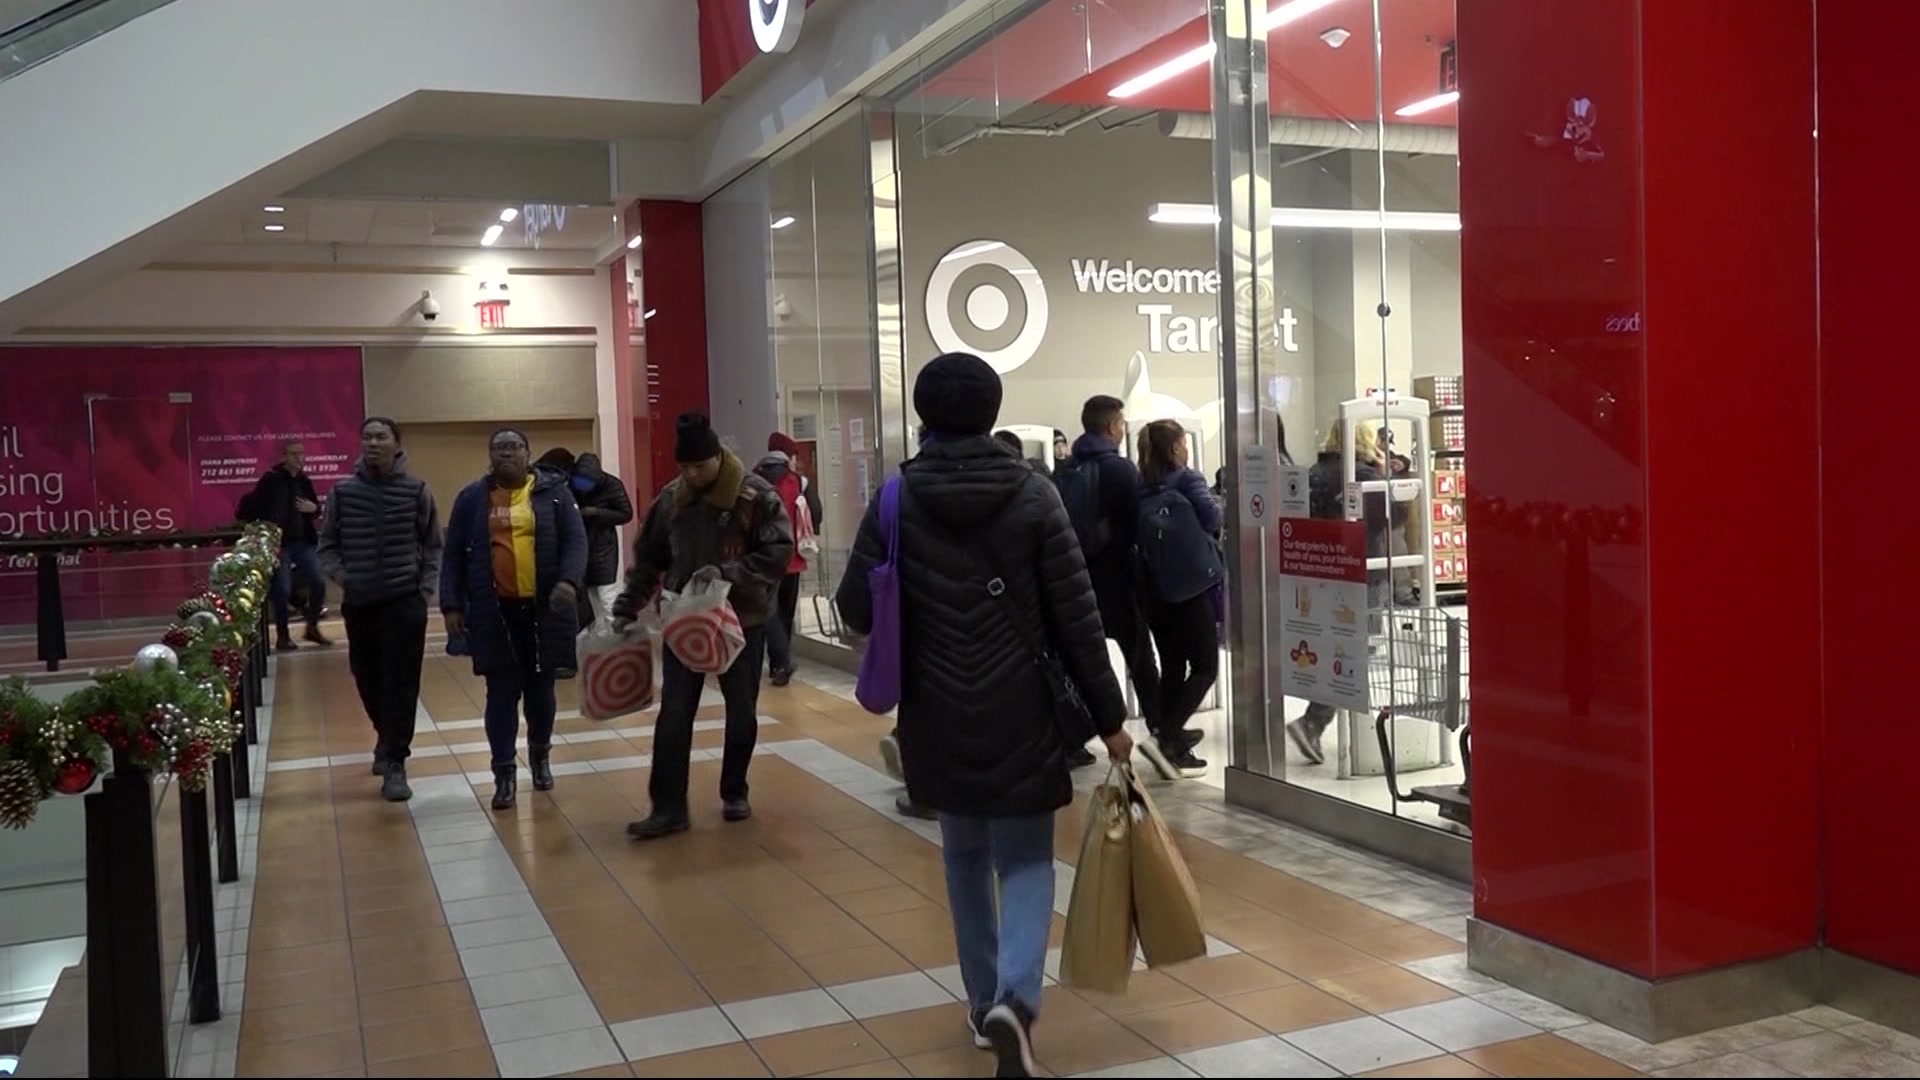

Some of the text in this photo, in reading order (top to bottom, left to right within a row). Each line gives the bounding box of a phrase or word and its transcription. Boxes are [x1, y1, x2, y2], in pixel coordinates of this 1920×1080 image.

[1071, 258, 1221, 294] Welcome
[480, 303, 506, 327] EXIT
[1138, 304, 1299, 353] Tart
[278, 432, 304, 440] LEASING
[201, 468, 216, 477] 212
[1294, 540, 1307, 551] first
[1307, 542, 1329, 554] priority
[8, 549, 82, 568] Ternal
[1322, 554, 1336, 564] your
